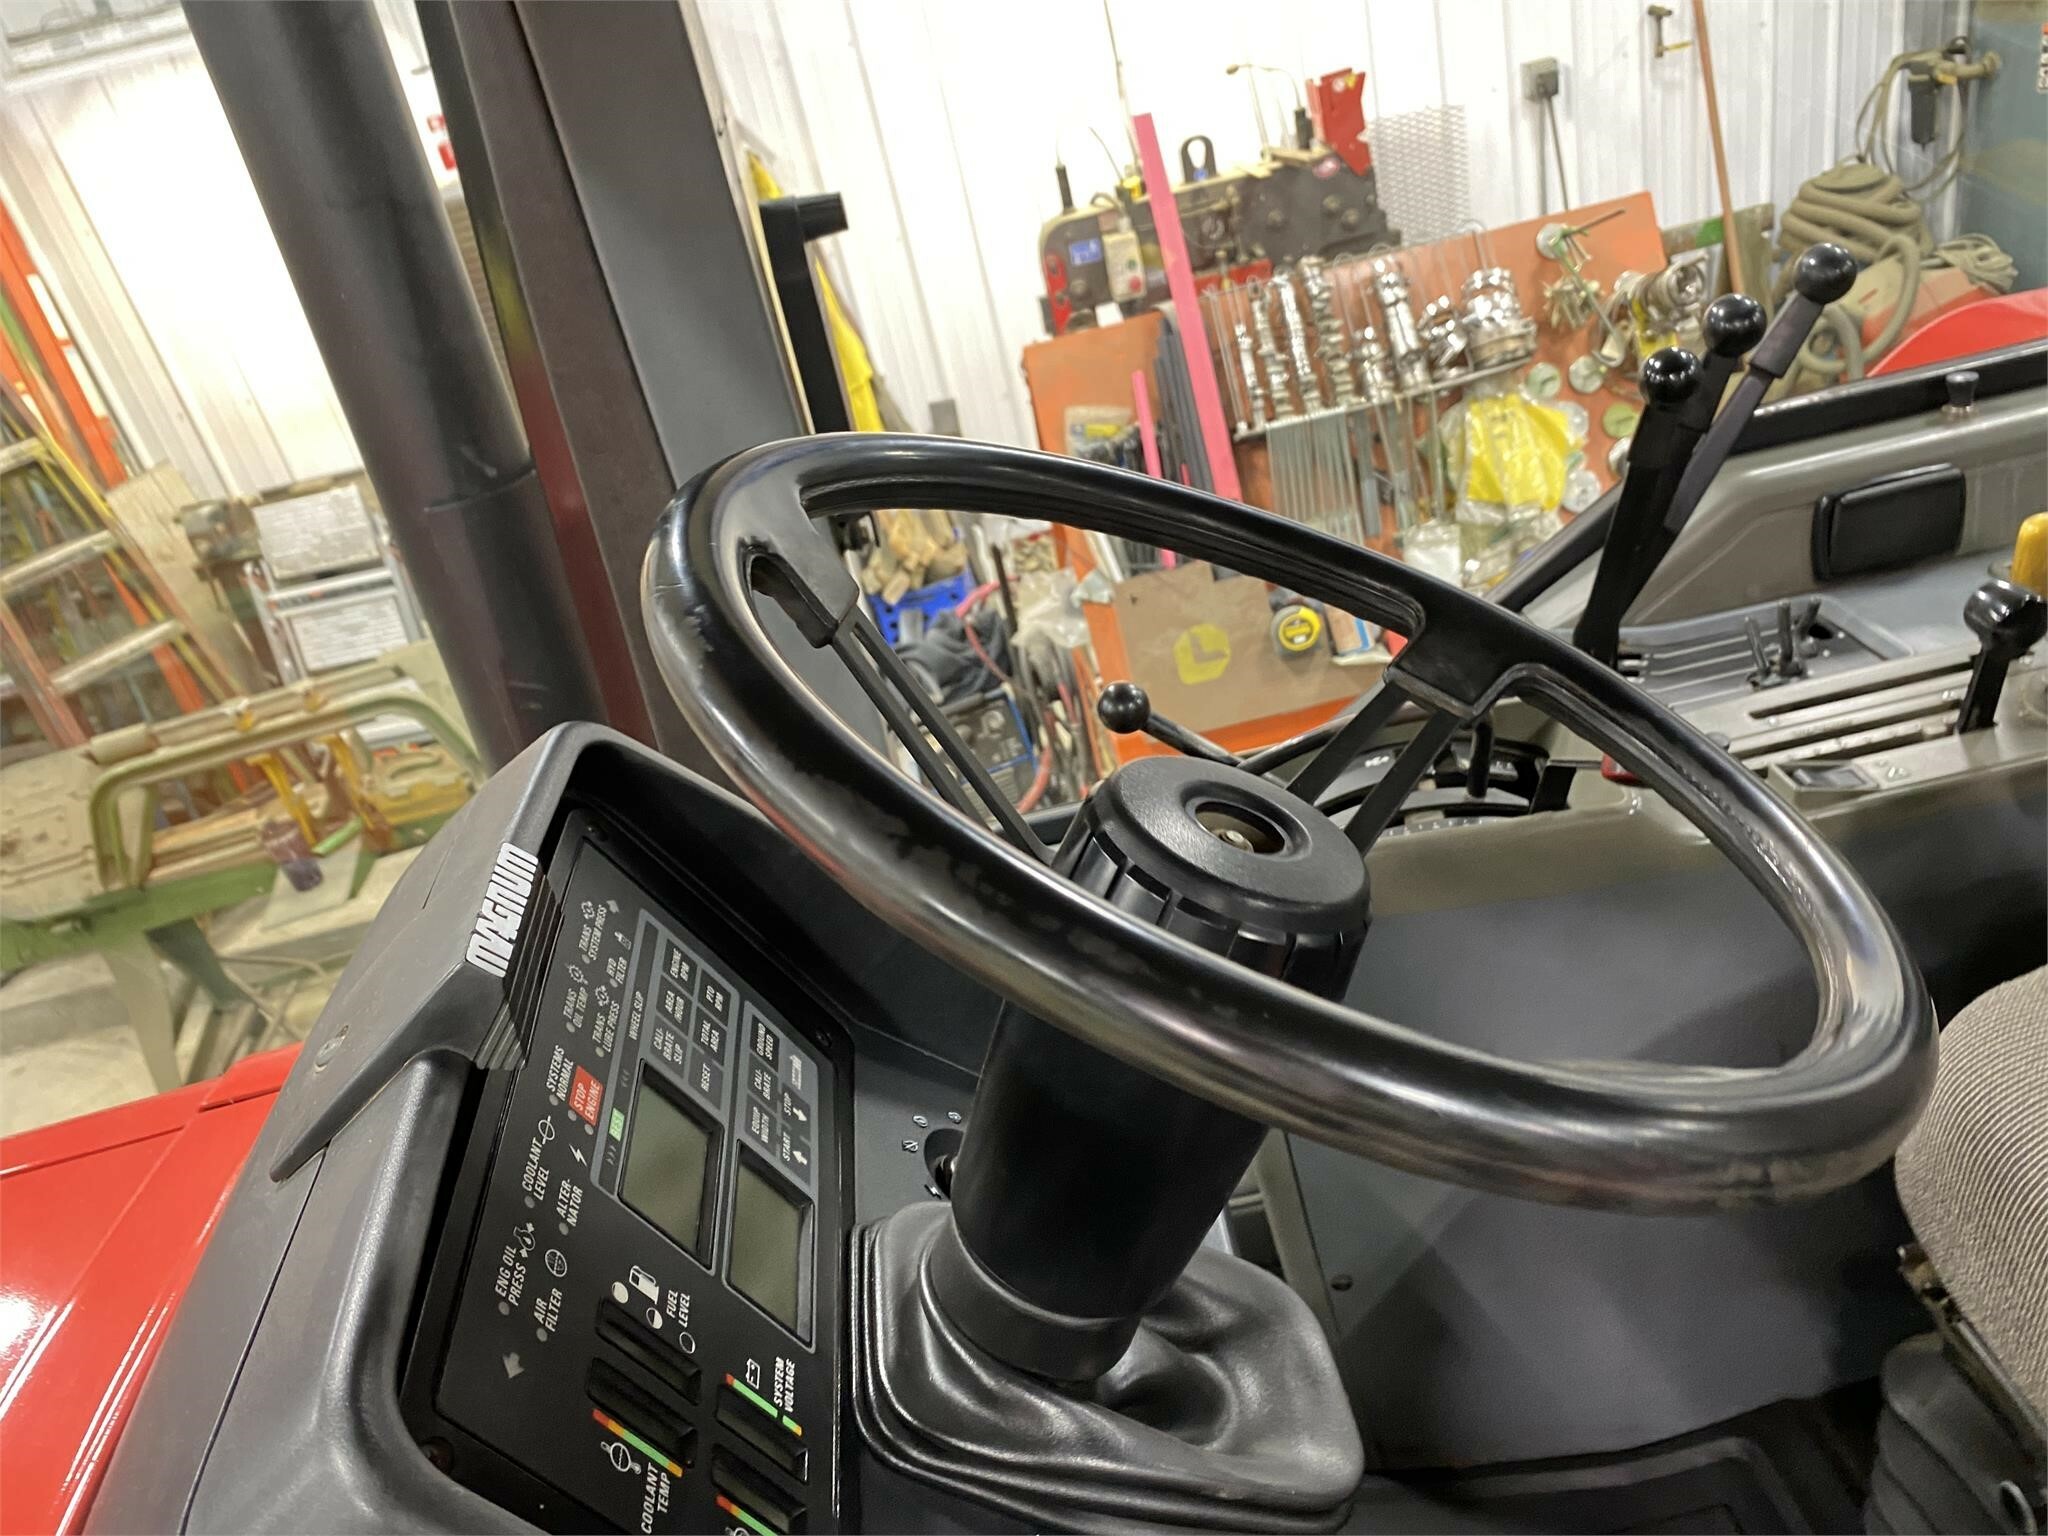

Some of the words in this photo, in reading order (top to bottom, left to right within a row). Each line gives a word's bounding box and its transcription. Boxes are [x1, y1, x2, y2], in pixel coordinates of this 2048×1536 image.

[466, 843, 539, 977] MAGNUM
[594, 904, 606, 930] PRESS
[579, 924, 591, 952] TRANS
[588, 927, 602, 960] SYSTEM
[606, 957, 616, 977] HYD
[616, 957, 627, 984] FILTER
[670, 948, 681, 979] ENGINE
[680, 961, 690, 981] RPM
[563, 988, 576, 1019] TRANS
[576, 987, 588, 1012] TEMP
[634, 991, 643, 1011] SLIP
[665, 990, 675, 1014] AREA
[706, 985, 715, 1003] PTO
[714, 992, 724, 1012] RPM
[573, 1012, 584, 1028] OIL
[592, 1012, 605, 1044] TRANS
[606, 1000, 620, 1029] PRESS
[629, 1010, 641, 1040] WHEEL
[603, 1028, 614, 1052] LUBE
[653, 1027, 663, 1050] CALI-
[663, 1031, 674, 1061] BRATE
[701, 1019, 711, 1045] TOTAL
[710, 1029, 720, 1052] AREA
[757, 1023, 766, 1056] GROUND
[674, 1043, 683, 1064] SLIP
[765, 1034, 773, 1060] SPEED
[546, 1045, 564, 1092] SYSTEMS
[556, 1057, 574, 1101] NORMAL
[701, 1063, 710, 1092] RESET
[574, 1083, 585, 1110] STOP
[584, 1080, 600, 1120] ENGINE
[763, 1072, 771, 1100] BRATE
[752, 1106, 760, 1134] EQUIP
[761, 1113, 769, 1143] WIDTH
[783, 1132, 791, 1161] START
[522, 1137, 542, 1191] COOLANT
[534, 1166, 549, 1200] LEVEL
[556, 1178, 572, 1218] ALTER-
[567, 1186, 583, 1226] NATOR
[502, 1245, 516, 1266] OIL
[495, 1267, 511, 1297] ENG
[508, 1262, 526, 1306] PRESS
[534, 1298, 547, 1324] AIR
[546, 1288, 562, 1332] FILTER
[666, 1290, 678, 1318] FUEL
[678, 1293, 690, 1327] LEVEL
[774, 1357, 785, 1407] SYSTEM
[784, 1359, 795, 1412] VOLTAGE
[641, 1462, 658, 1534] COOLANT
[657, 1472, 671, 1513] TEMP
